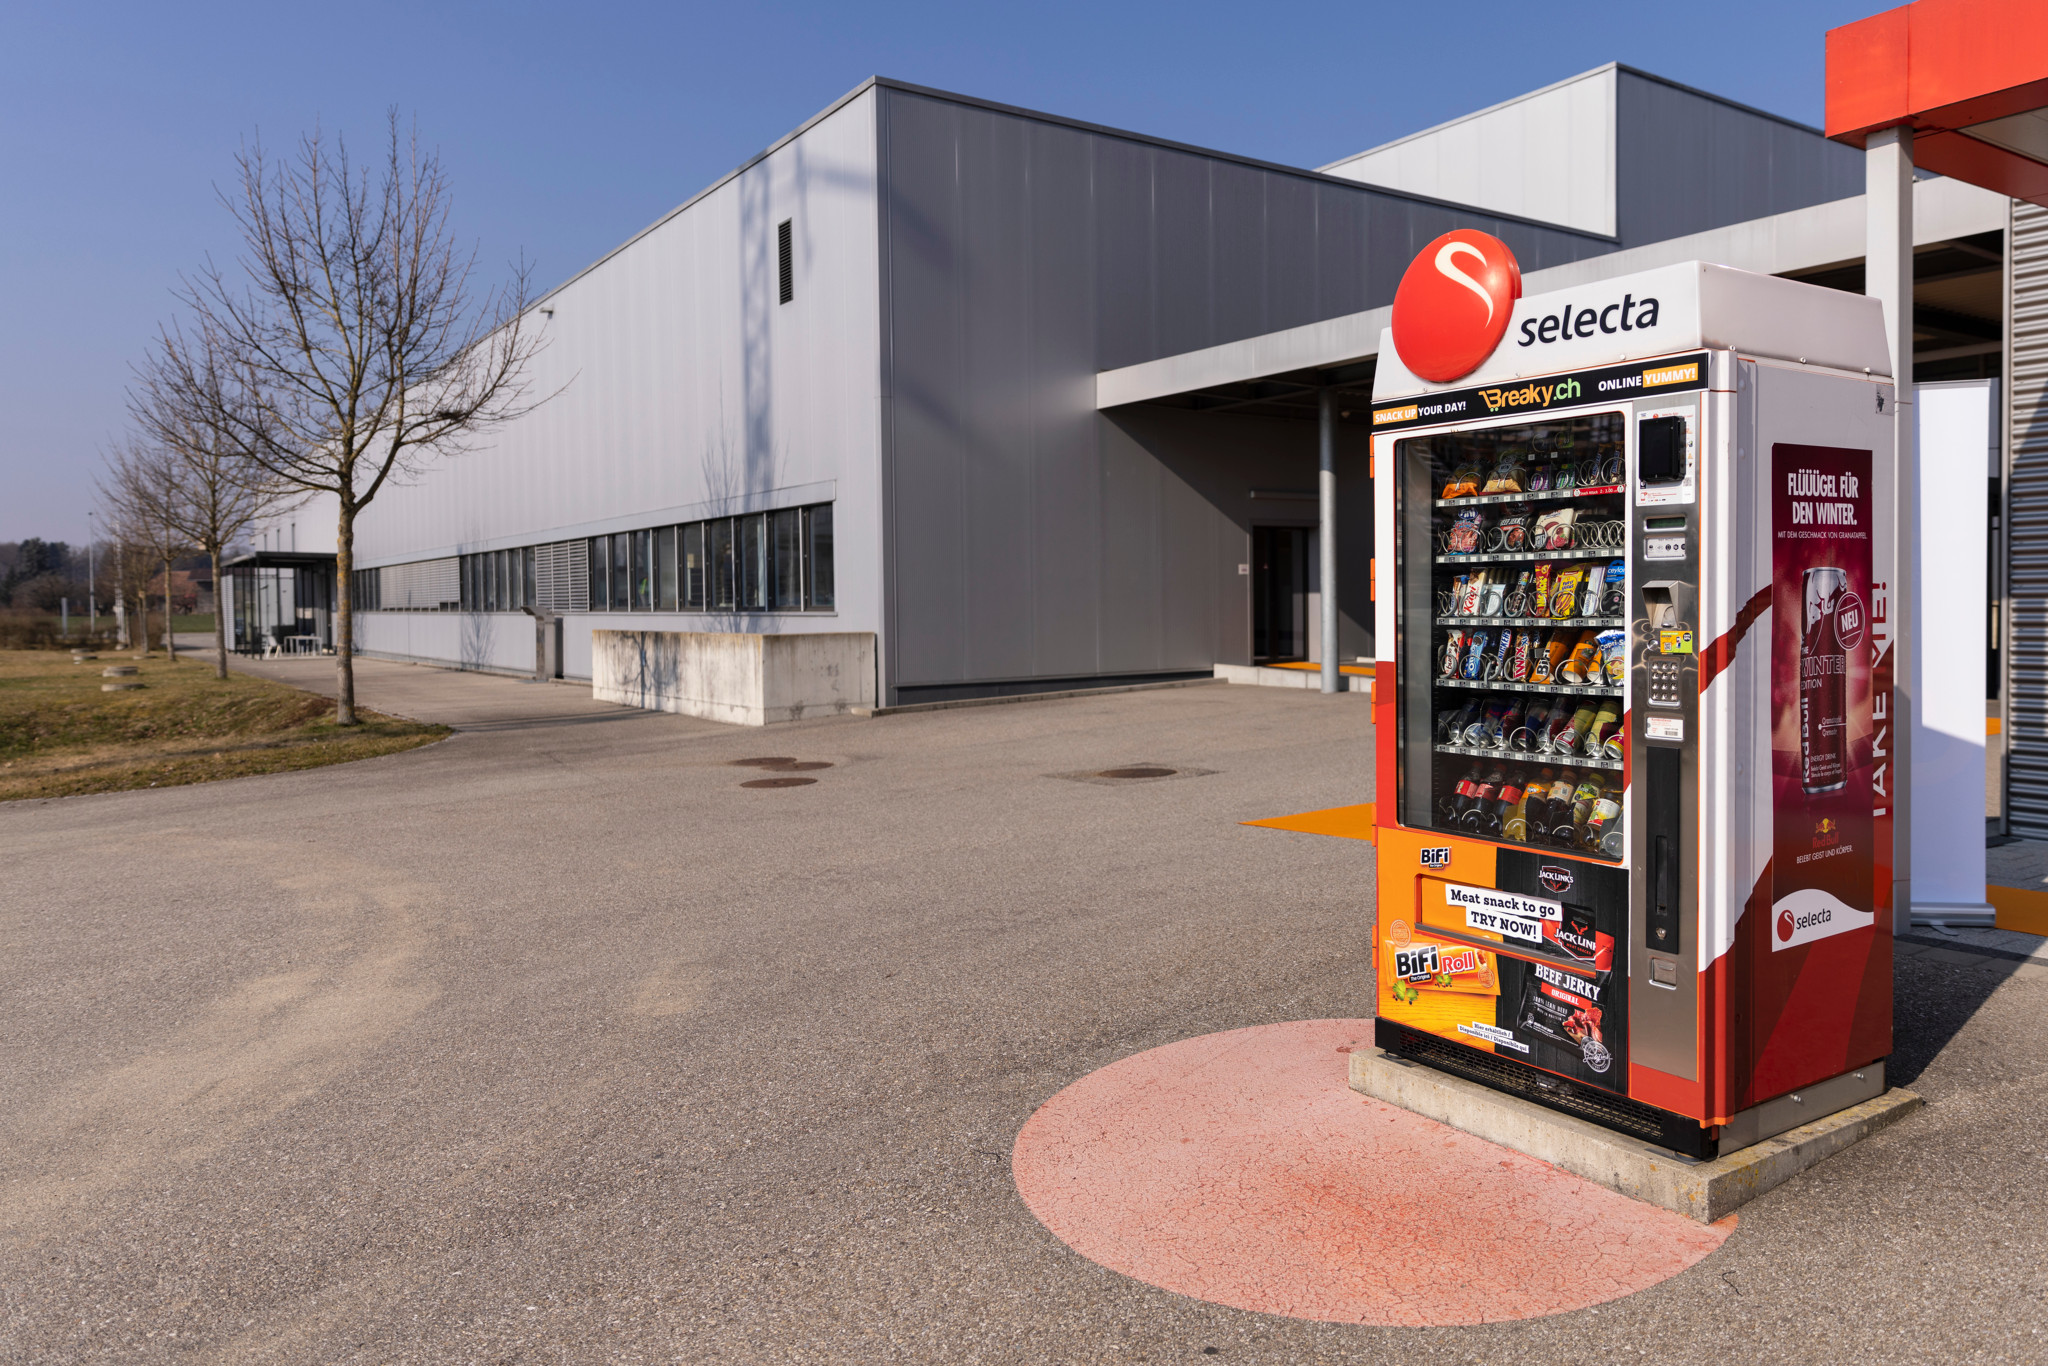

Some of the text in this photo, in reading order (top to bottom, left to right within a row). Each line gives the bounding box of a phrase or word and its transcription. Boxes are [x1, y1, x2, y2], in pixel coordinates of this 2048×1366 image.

[1517, 293, 1660, 347] selecta
[1598, 367, 1696, 391] ONLINE YUMMY!
[1478, 378, 1581, 412] Breaky.ch
[1375, 401, 1467, 423] SNACK UP YOUR DAY!
[1788, 468, 1859, 498] FLÜÜÜGEL FÜR
[1792, 501, 1857, 525] DEN WINTER.
[1798, 531, 1827, 539] GESCHMACK
[1828, 531, 1838, 539] VON
[1840, 609, 1859, 633] NEU
[1812, 831, 1839, 849] Red Bull
[1421, 848, 1449, 863] BiFi
[1796, 854, 1811, 864] BELEBT
[1812, 850, 1825, 860] GEIST
[1825, 849, 1836, 857] UND
[1450, 889, 1556, 917] Meat snack to go
[1471, 911, 1537, 940] TRY NOW!
[1796, 907, 1832, 930] selecta
[1554, 928, 1578, 945] JACK
[1396, 946, 1474, 978] BiFi Roll
[1534, 963, 1601, 1001] BEEF JERKY
[1551, 988, 1580, 1006] ORIGINAL
[1459, 1025, 1483, 1038] Disponible
[1474, 1022, 1484, 1031] Hier
[1484, 1026, 1508, 1037] erhältlich
